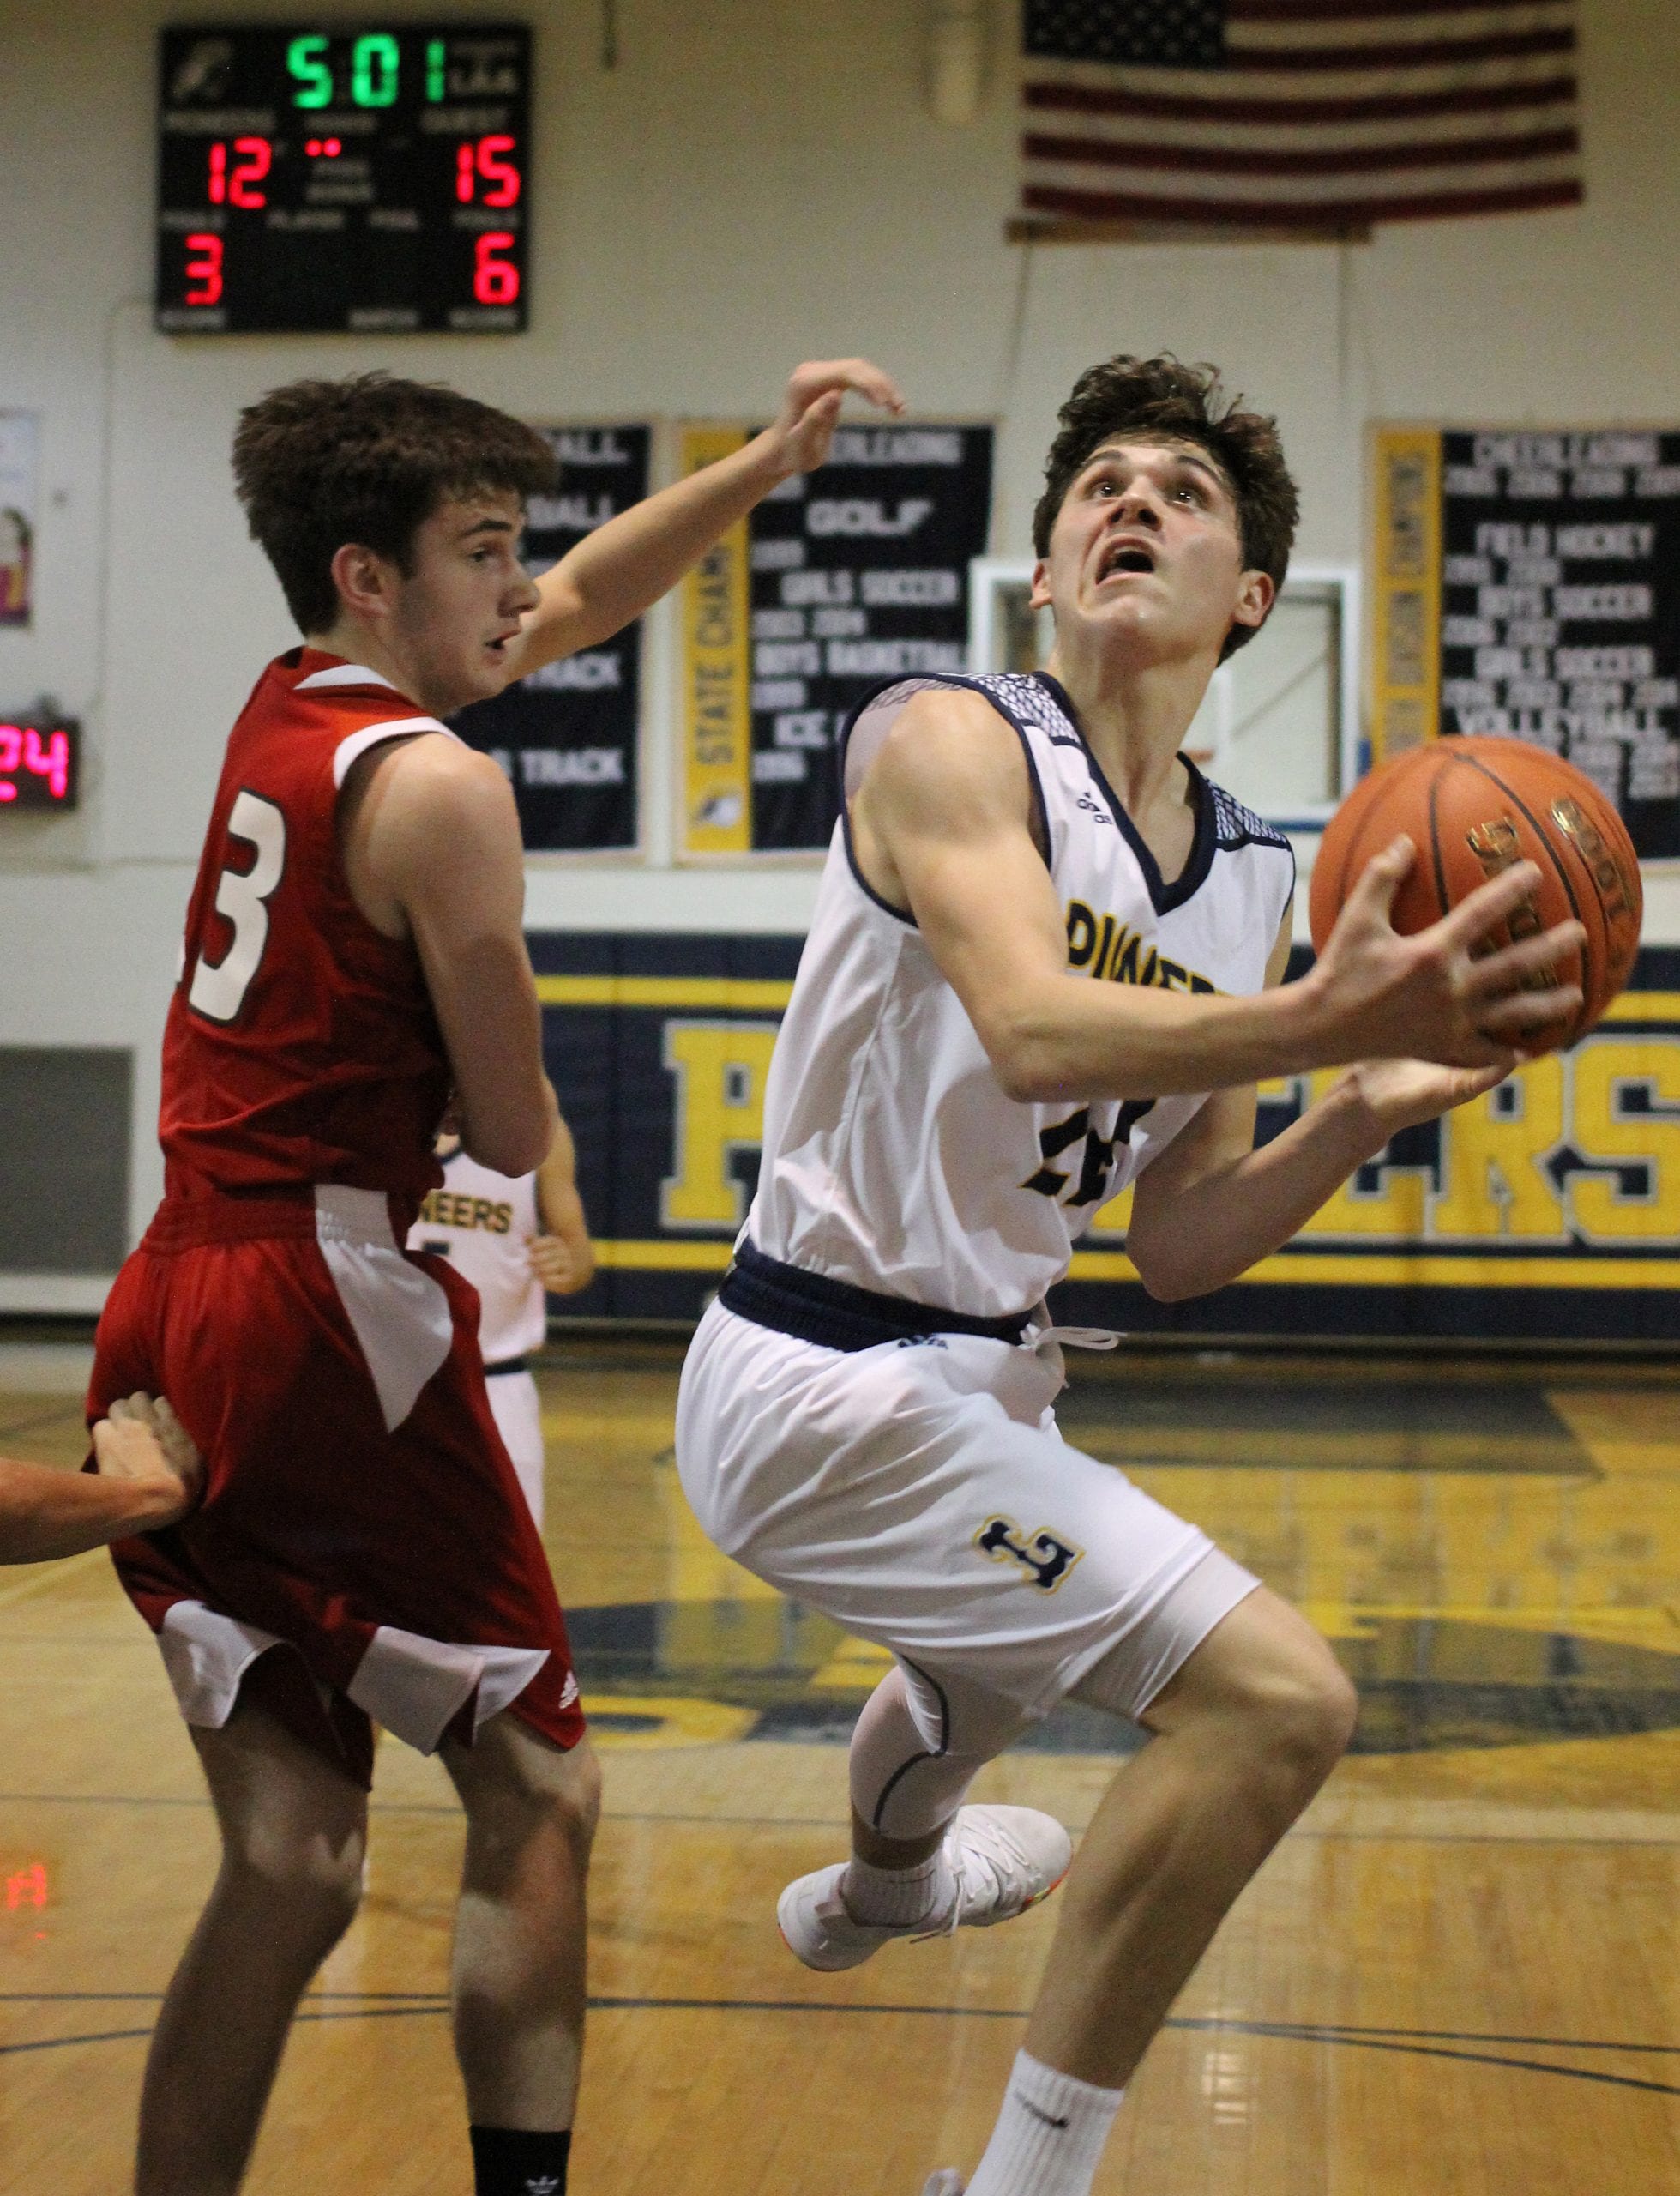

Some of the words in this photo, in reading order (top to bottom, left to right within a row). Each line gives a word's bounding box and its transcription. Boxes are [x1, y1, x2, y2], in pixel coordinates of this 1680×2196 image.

[208, 136, 272, 208] 12
[455, 135, 520, 208] 15
[184, 232, 223, 305] 3
[473, 231, 520, 304] 6
[806, 498, 932, 538] GOLF
[1475, 523, 1549, 558] FIELD
[1555, 522, 1655, 558] HOCKEY
[780, 570, 853, 604] GIRLS
[861, 570, 958, 606] SOCCER
[1478, 587, 1545, 619] BOYS
[1553, 586, 1653, 619] SOCCER
[755, 643, 819, 674] BOYS
[1475, 648, 1548, 681] GIRLS
[1555, 647, 1654, 680] SOCCER
[695, 663, 734, 767] STATE
[775, 713, 828, 747] ICE
[520, 747, 624, 787] TRACK
[188, 785, 286, 1028] 3
[971, 1511, 1087, 1596] L
